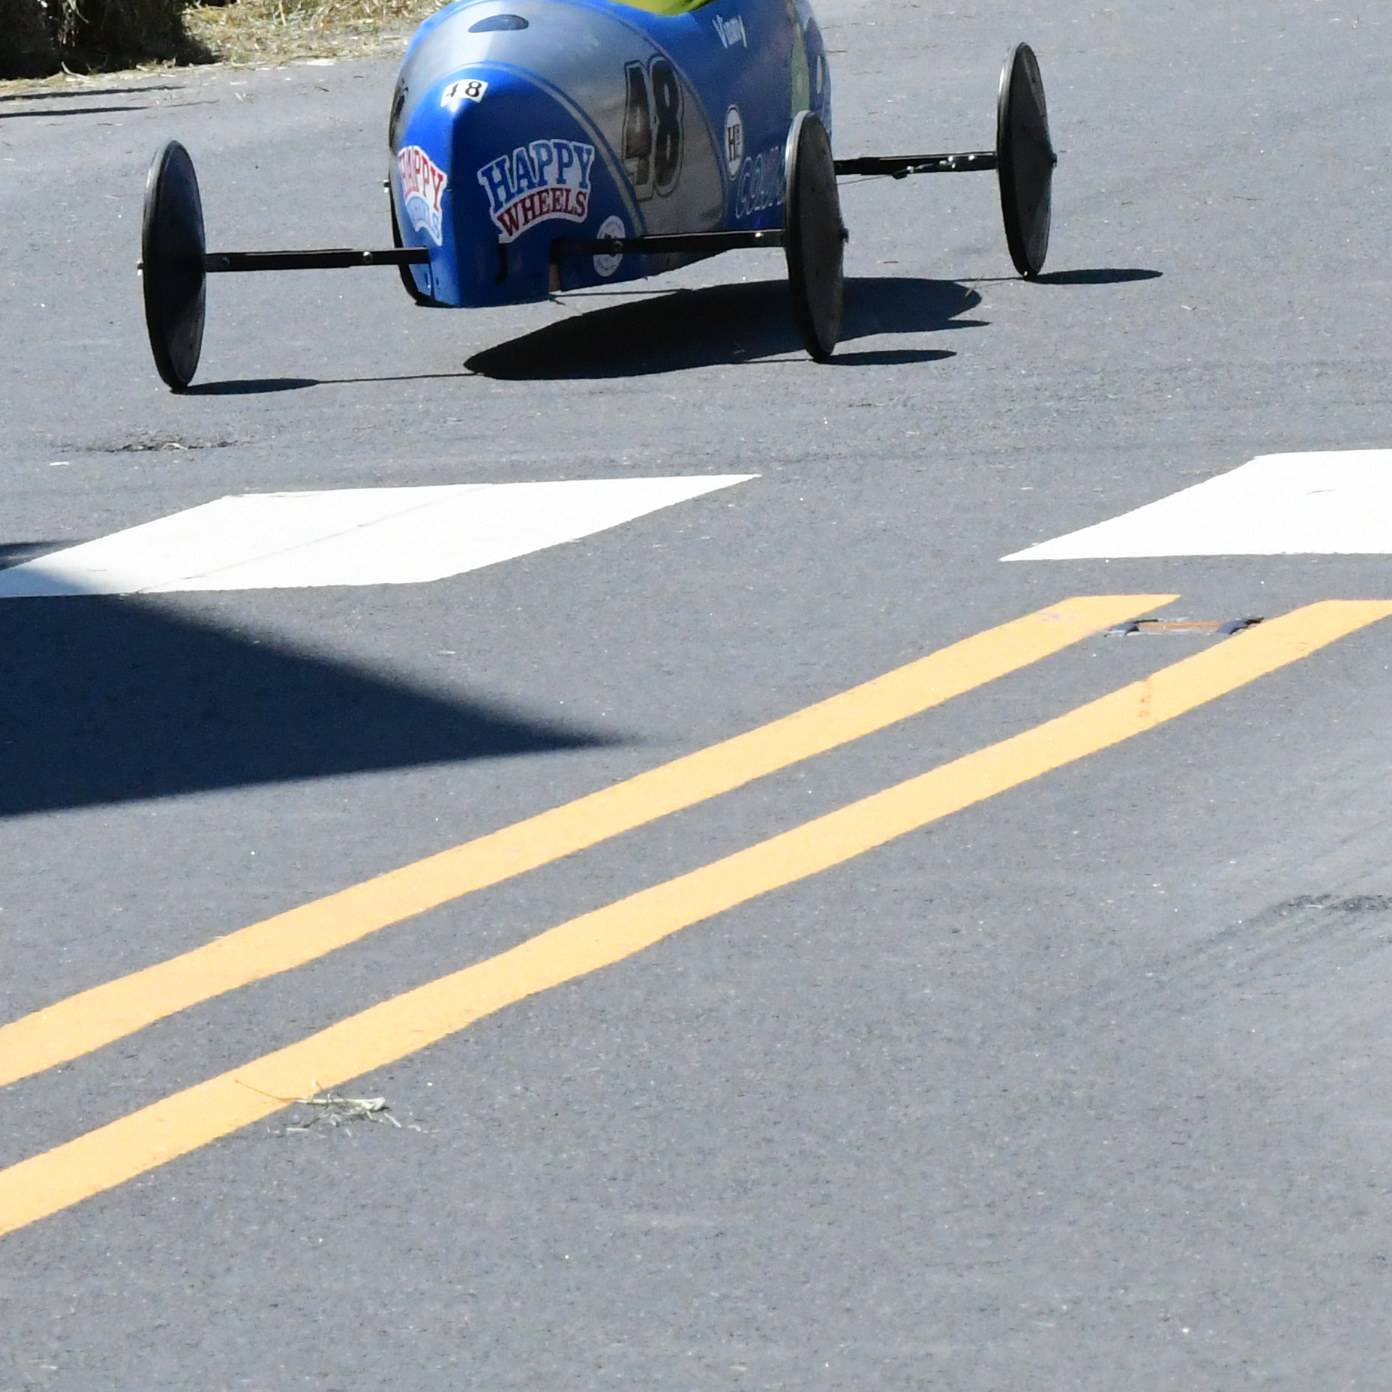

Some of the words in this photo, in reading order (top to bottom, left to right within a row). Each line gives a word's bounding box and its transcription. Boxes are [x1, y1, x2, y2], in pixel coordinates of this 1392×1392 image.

[622, 54, 685, 203] 48
[480, 141, 594, 212] HAPPY
[496, 186, 589, 238] WHEELS
